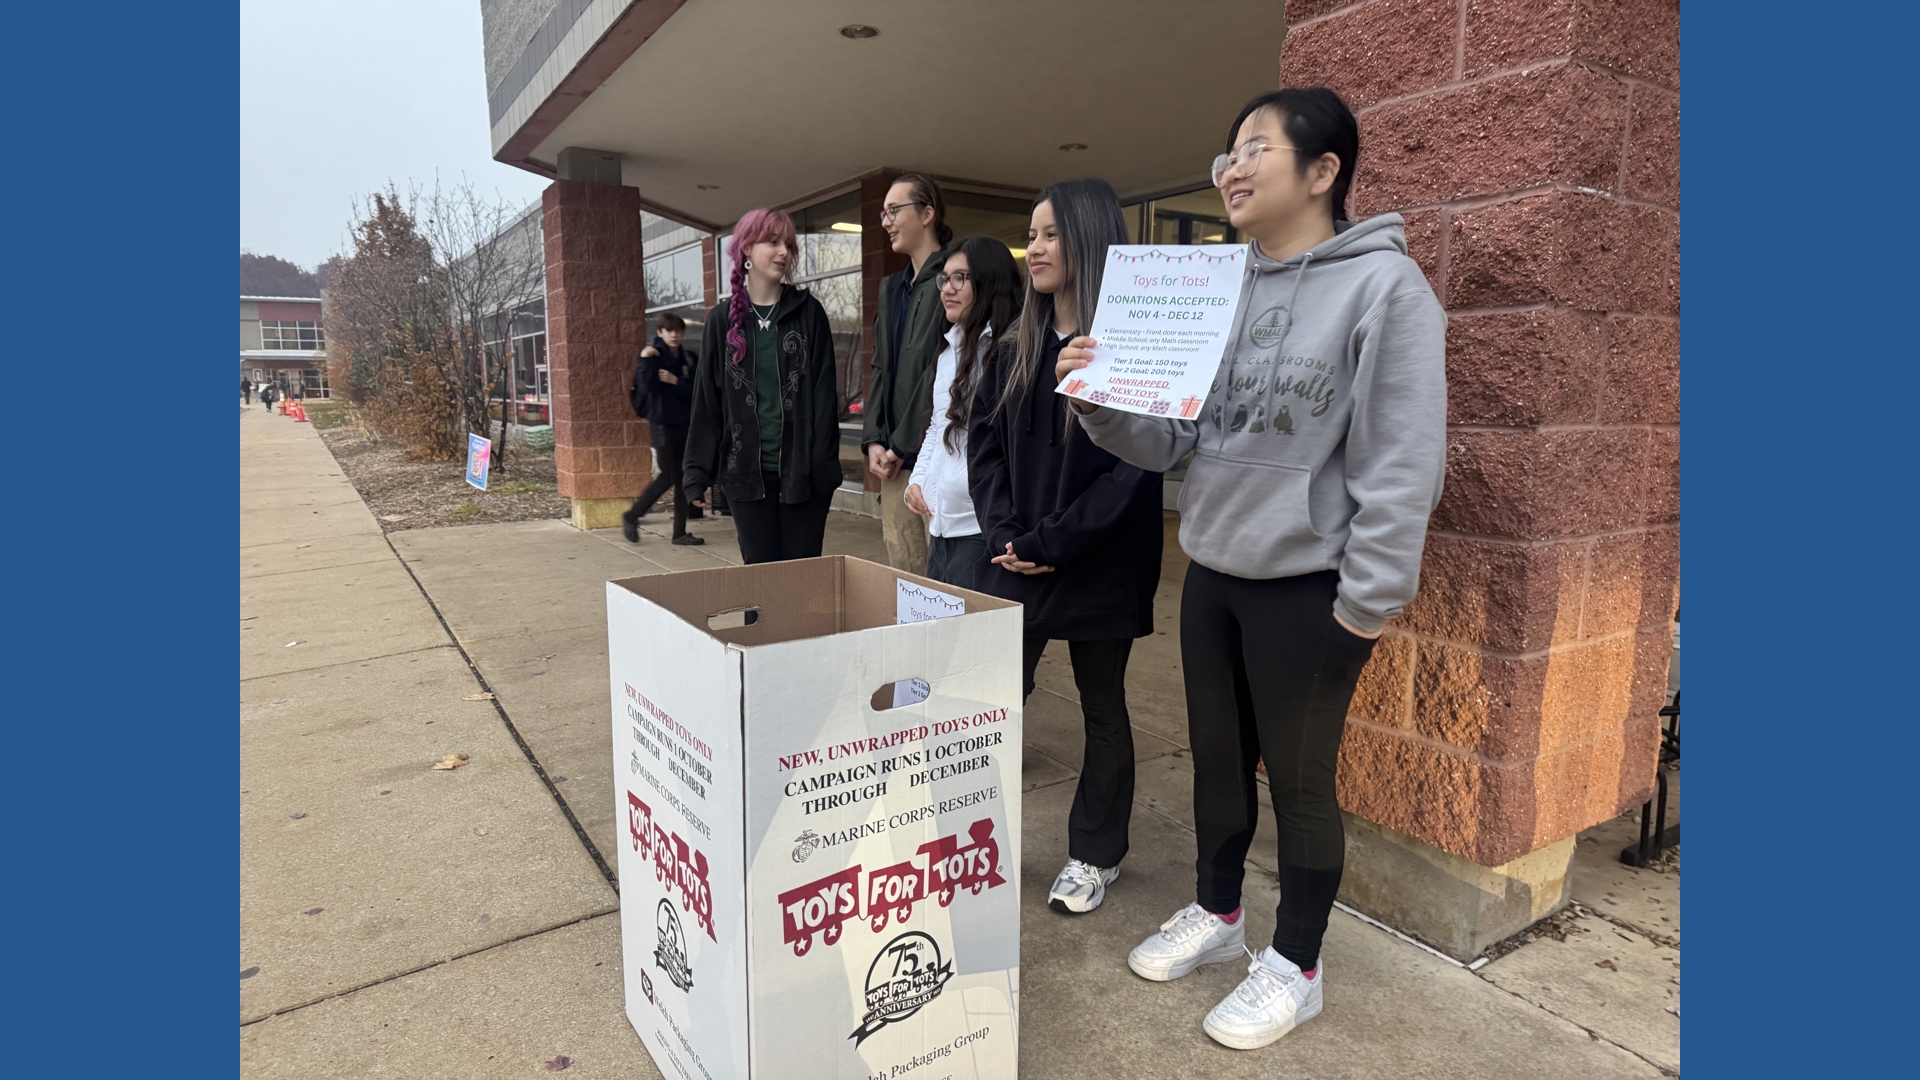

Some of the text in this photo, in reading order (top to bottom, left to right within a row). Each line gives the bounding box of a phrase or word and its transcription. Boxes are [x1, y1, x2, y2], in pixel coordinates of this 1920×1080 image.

[1133, 274, 1210, 288] Toys for Tots!
[1107, 294, 1230, 306] DONATIONS ACCEPTED:
[1128, 309, 1151, 319] NOV
[1152, 310, 1159, 319] 4
[1168, 311, 1190, 320] DEC
[1191, 311, 1204, 320] 12
[1106, 335, 1127, 343] Middle
[1177, 337, 1209, 345] classroom
[1109, 328, 1142, 336] Elementary
[1193, 330, 1220, 338] morning
[1103, 342, 1118, 350] High
[1168, 345, 1200, 353] classroom
[1134, 358, 1154, 366] Goal:
[1170, 360, 1188, 368] toys
[1167, 369, 1185, 377] toys
[1247, 356, 1336, 375] CLASROOMS
[1107, 376, 1170, 389] UNWRAPPED
[1109, 386, 1160, 399] NEW TOYS
[1274, 373, 1336, 417] walls
[1109, 395, 1150, 408] NEEDED
[910, 607, 922, 620] Toys
[624, 681, 713, 761] NEW, UNWRAPPED TOYS ONLY
[627, 704, 713, 785] CAMPAIGN RUNS 1 OCTOBER
[778, 707, 1010, 772] NEW, UNWRAPPED TOYS ONLY
[633, 726, 706, 801] THROUGH DECEMBER
[784, 731, 1003, 798] CAMPAIGN RUNS 1 OCTOBER
[801, 754, 990, 816] THROUGH DECEMBER
[639, 762, 711, 841] MARINE CORPS RESERVE
[821, 786, 998, 849] MARINE CORPS RESERVE
[629, 803, 708, 916] TOYS FOR TOTS
[786, 847, 991, 931] TOYS FOR TOTS
[887, 941, 924, 978] 75th
[866, 971, 935, 1004] TOYS FOR TOTS
[873, 991, 933, 1019] ANNIVERSARY
[890, 1043, 952, 1078] Packaging
[954, 1026, 990, 1049] Group
[695, 1054, 713, 1080] Grou
